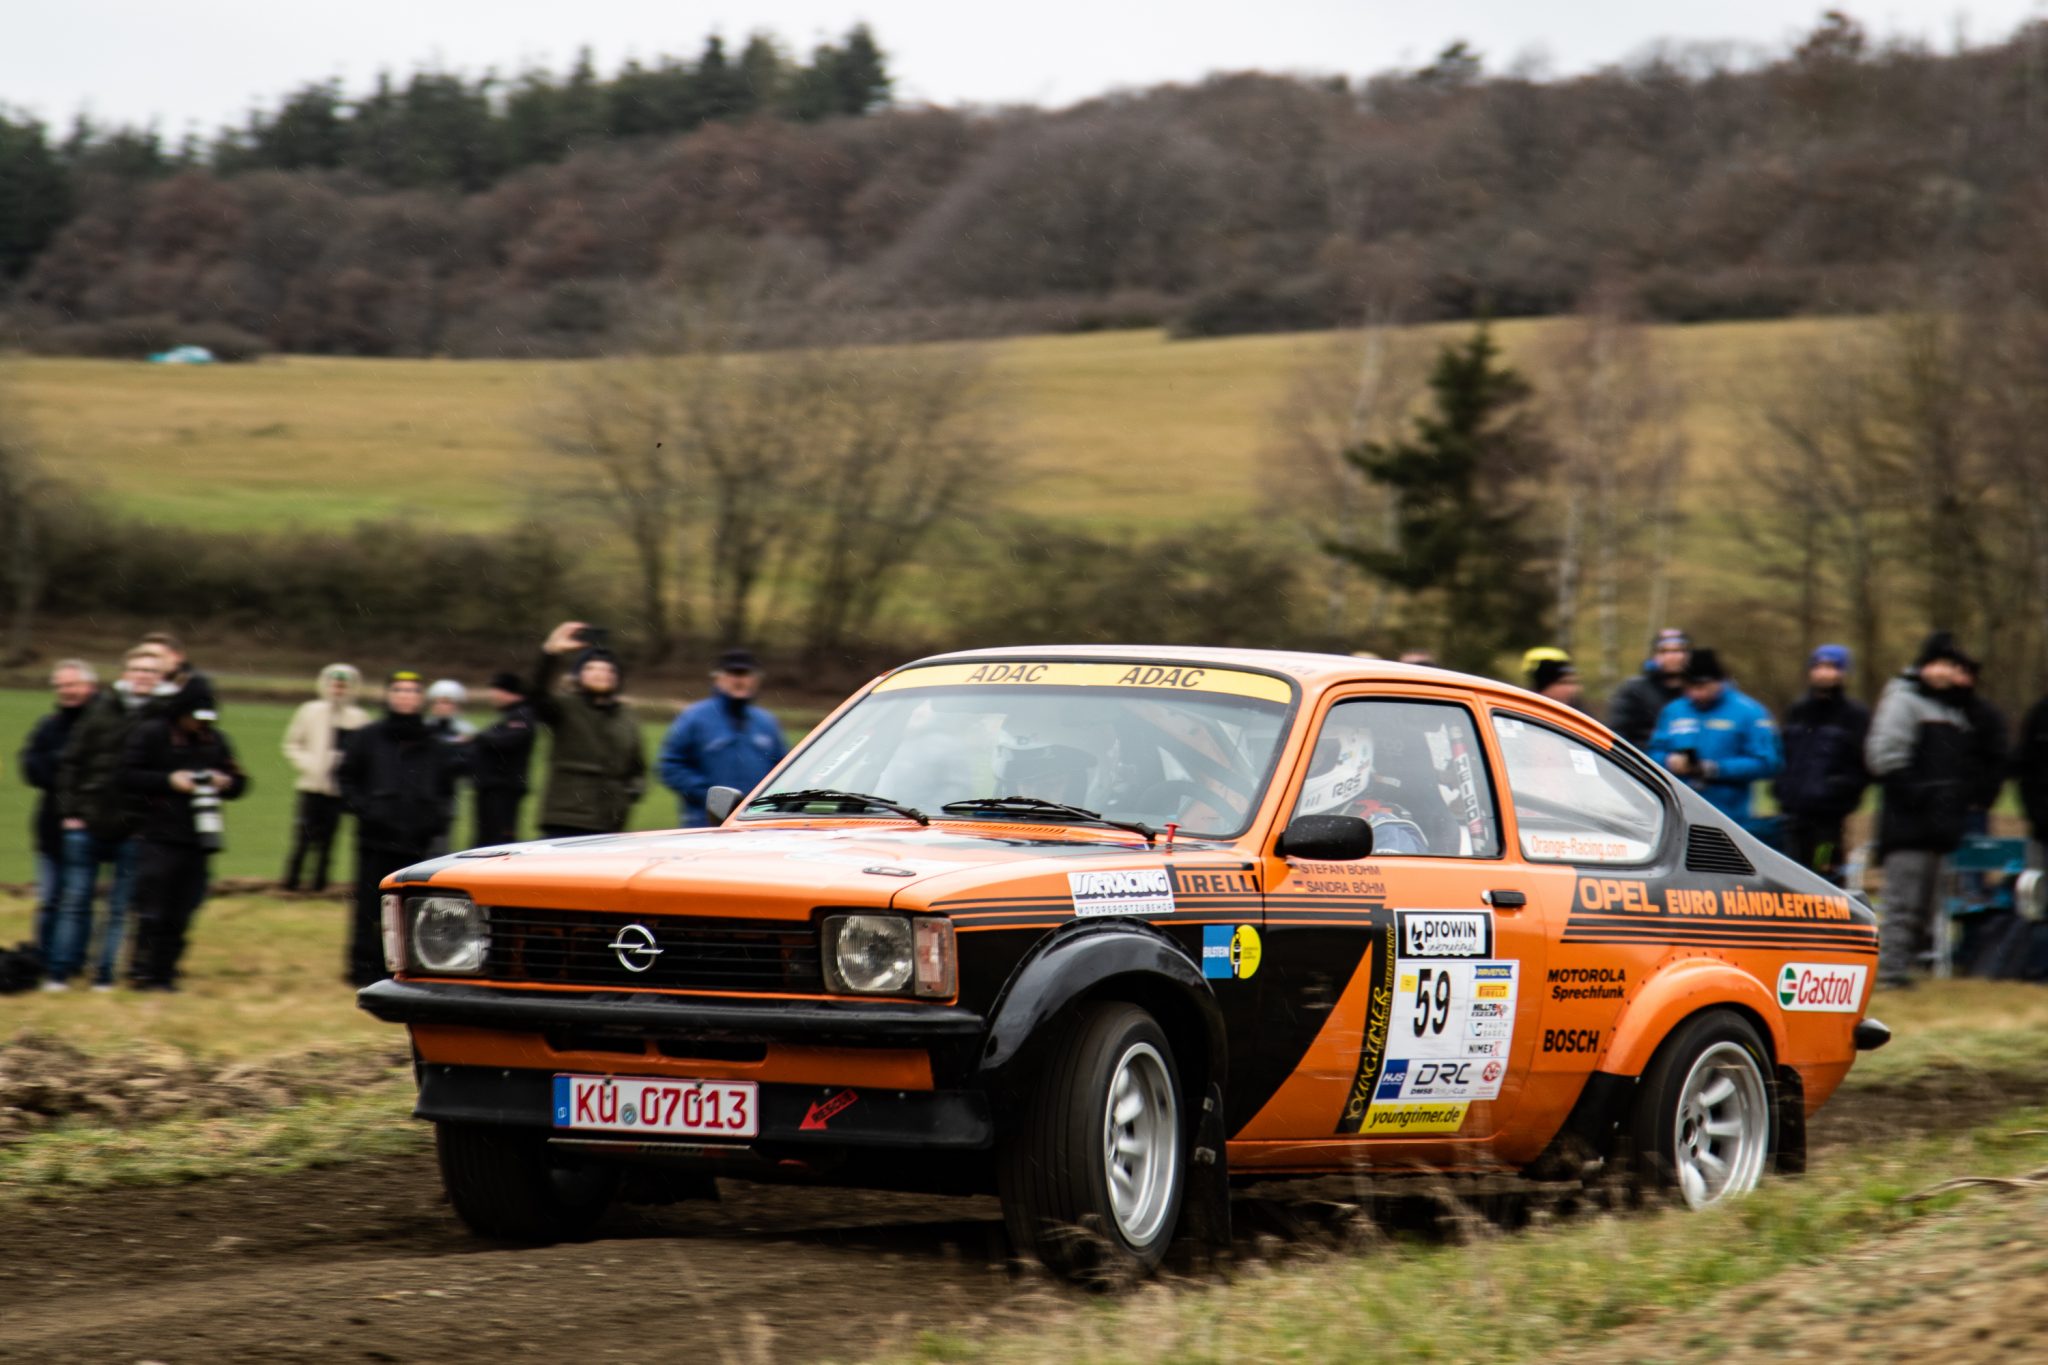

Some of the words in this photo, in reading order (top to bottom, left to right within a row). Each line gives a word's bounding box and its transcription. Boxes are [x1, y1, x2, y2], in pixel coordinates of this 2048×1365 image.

[968, 664, 1048, 683] ADAC
[1118, 667, 1205, 688] ADAC
[1531, 835, 1628, 861] Orange-Racing.com
[1302, 864, 1345, 875] STEFAN
[1349, 863, 1381, 876] BÖHM
[1306, 880, 1350, 893] SANDRA
[1353, 879, 1385, 893] BÖHM
[1579, 877, 1660, 913] OPEL
[1665, 888, 1717, 916] EURO
[1724, 884, 1850, 920] HÄNDLERTEAM
[1547, 968, 1626, 983] MOTOROLA
[1551, 985, 1626, 1001] Sprechfunk
[1798, 970, 1856, 1005] Castrol
[1413, 968, 1451, 1038] 59
[1543, 1029, 1600, 1053] BOSCH
[1382, 1072, 1406, 1082] HJS
[1414, 1063, 1472, 1085] DRC
[641, 1086, 747, 1129] 07013
[1369, 1106, 1461, 1128] youngtimer.de
